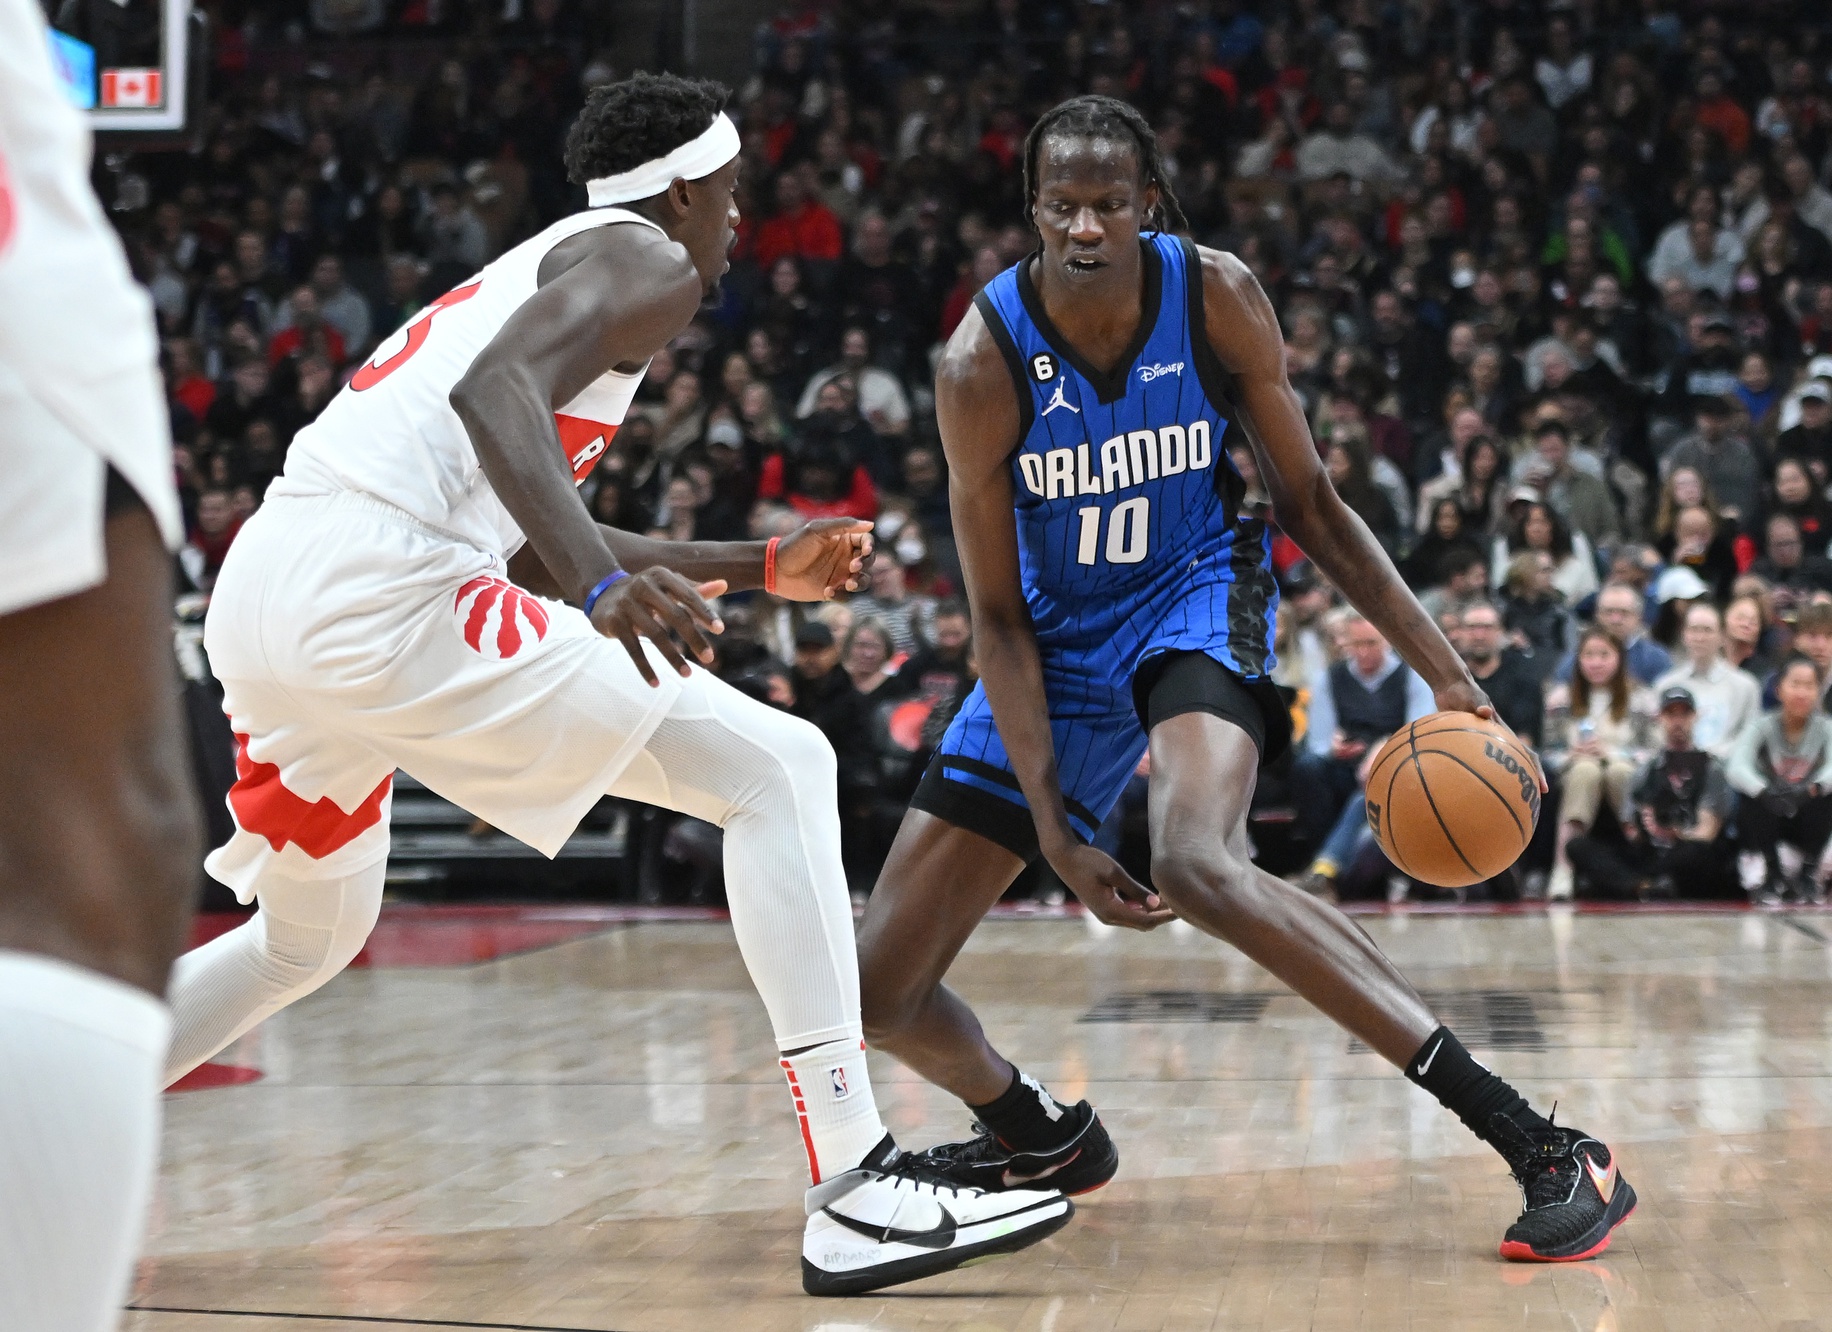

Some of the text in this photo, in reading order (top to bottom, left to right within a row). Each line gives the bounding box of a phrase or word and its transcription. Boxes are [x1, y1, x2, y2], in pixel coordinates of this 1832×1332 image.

[1034, 355, 1053, 380] 6
[1018, 420, 1211, 499] ORLANDO
[1077, 496, 1149, 565] 10
